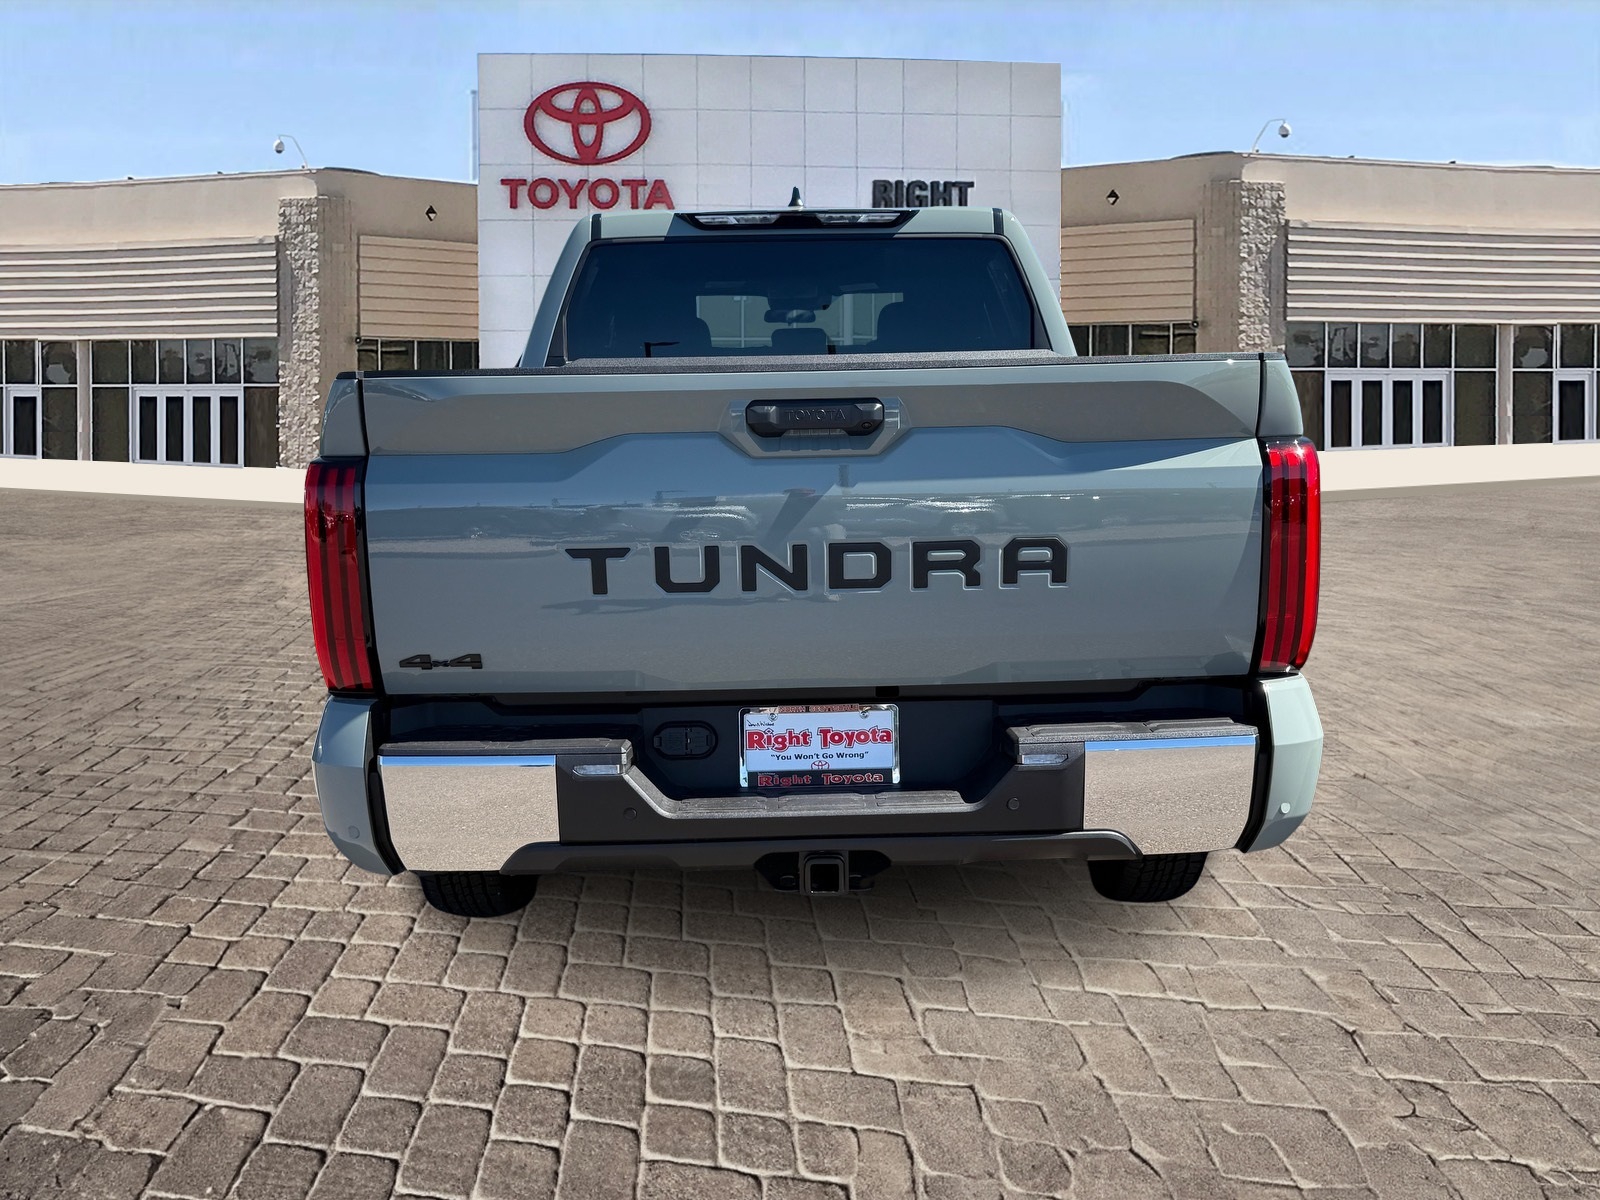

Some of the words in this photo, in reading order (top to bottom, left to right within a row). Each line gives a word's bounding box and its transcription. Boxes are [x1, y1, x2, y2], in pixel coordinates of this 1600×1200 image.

[501, 178, 675, 209] TOYOTA
[872, 179, 975, 208] RIGHT
[785, 408, 846, 420] TOYOTA
[564, 536, 1068, 595] TUNDRA
[746, 728, 812, 752] Right
[817, 726, 893, 749] Toyota
[758, 774, 812, 787] Right
[821, 772, 884, 785] Toyota
